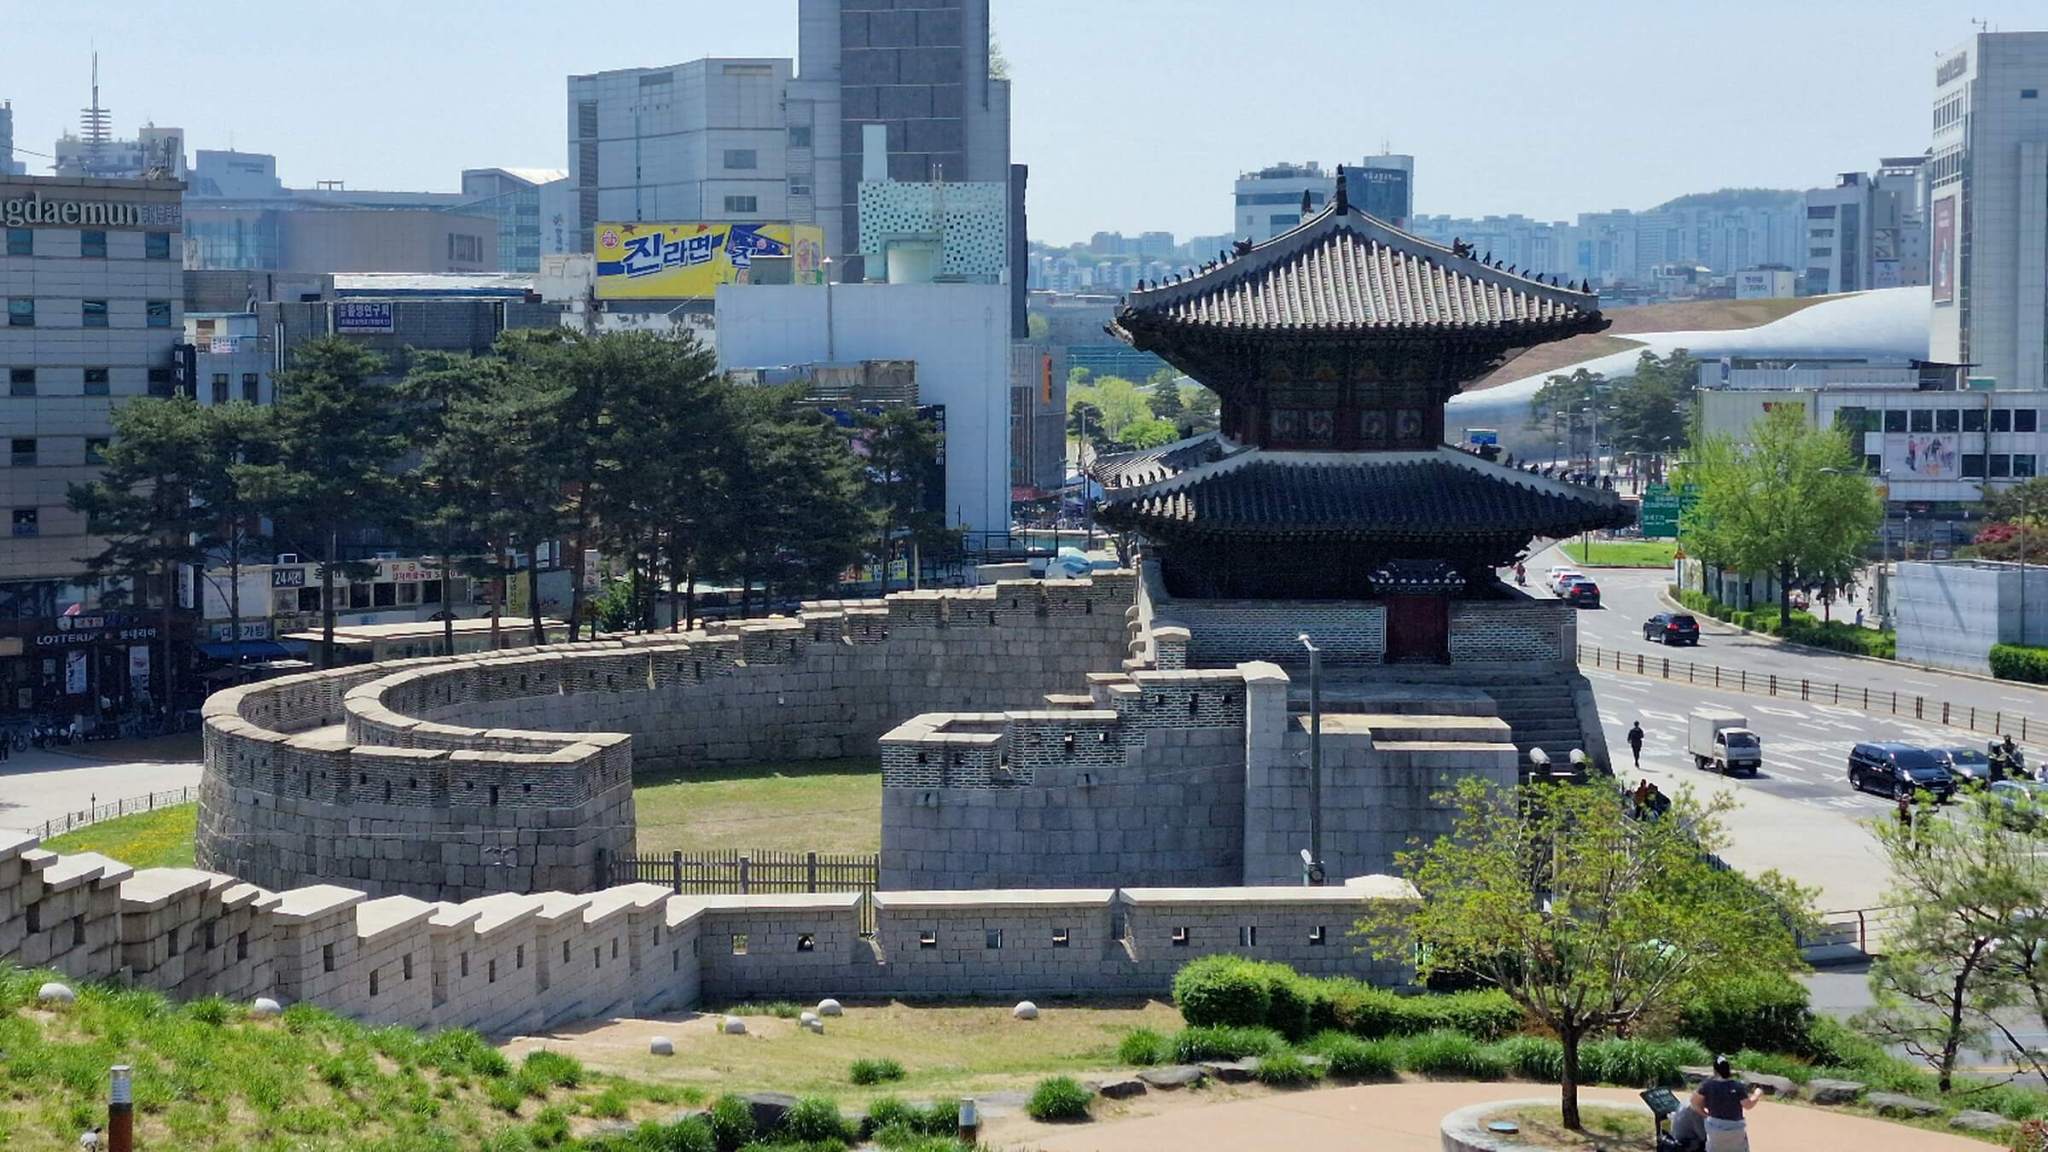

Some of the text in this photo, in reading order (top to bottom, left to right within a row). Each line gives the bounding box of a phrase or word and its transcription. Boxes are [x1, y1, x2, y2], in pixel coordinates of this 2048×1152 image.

[0, 191, 142, 227] gdaemun
[621, 232, 713, 278] 진라면
[274, 571, 303, 585] 24시간
[36, 630, 98, 646] LOTTERIA
